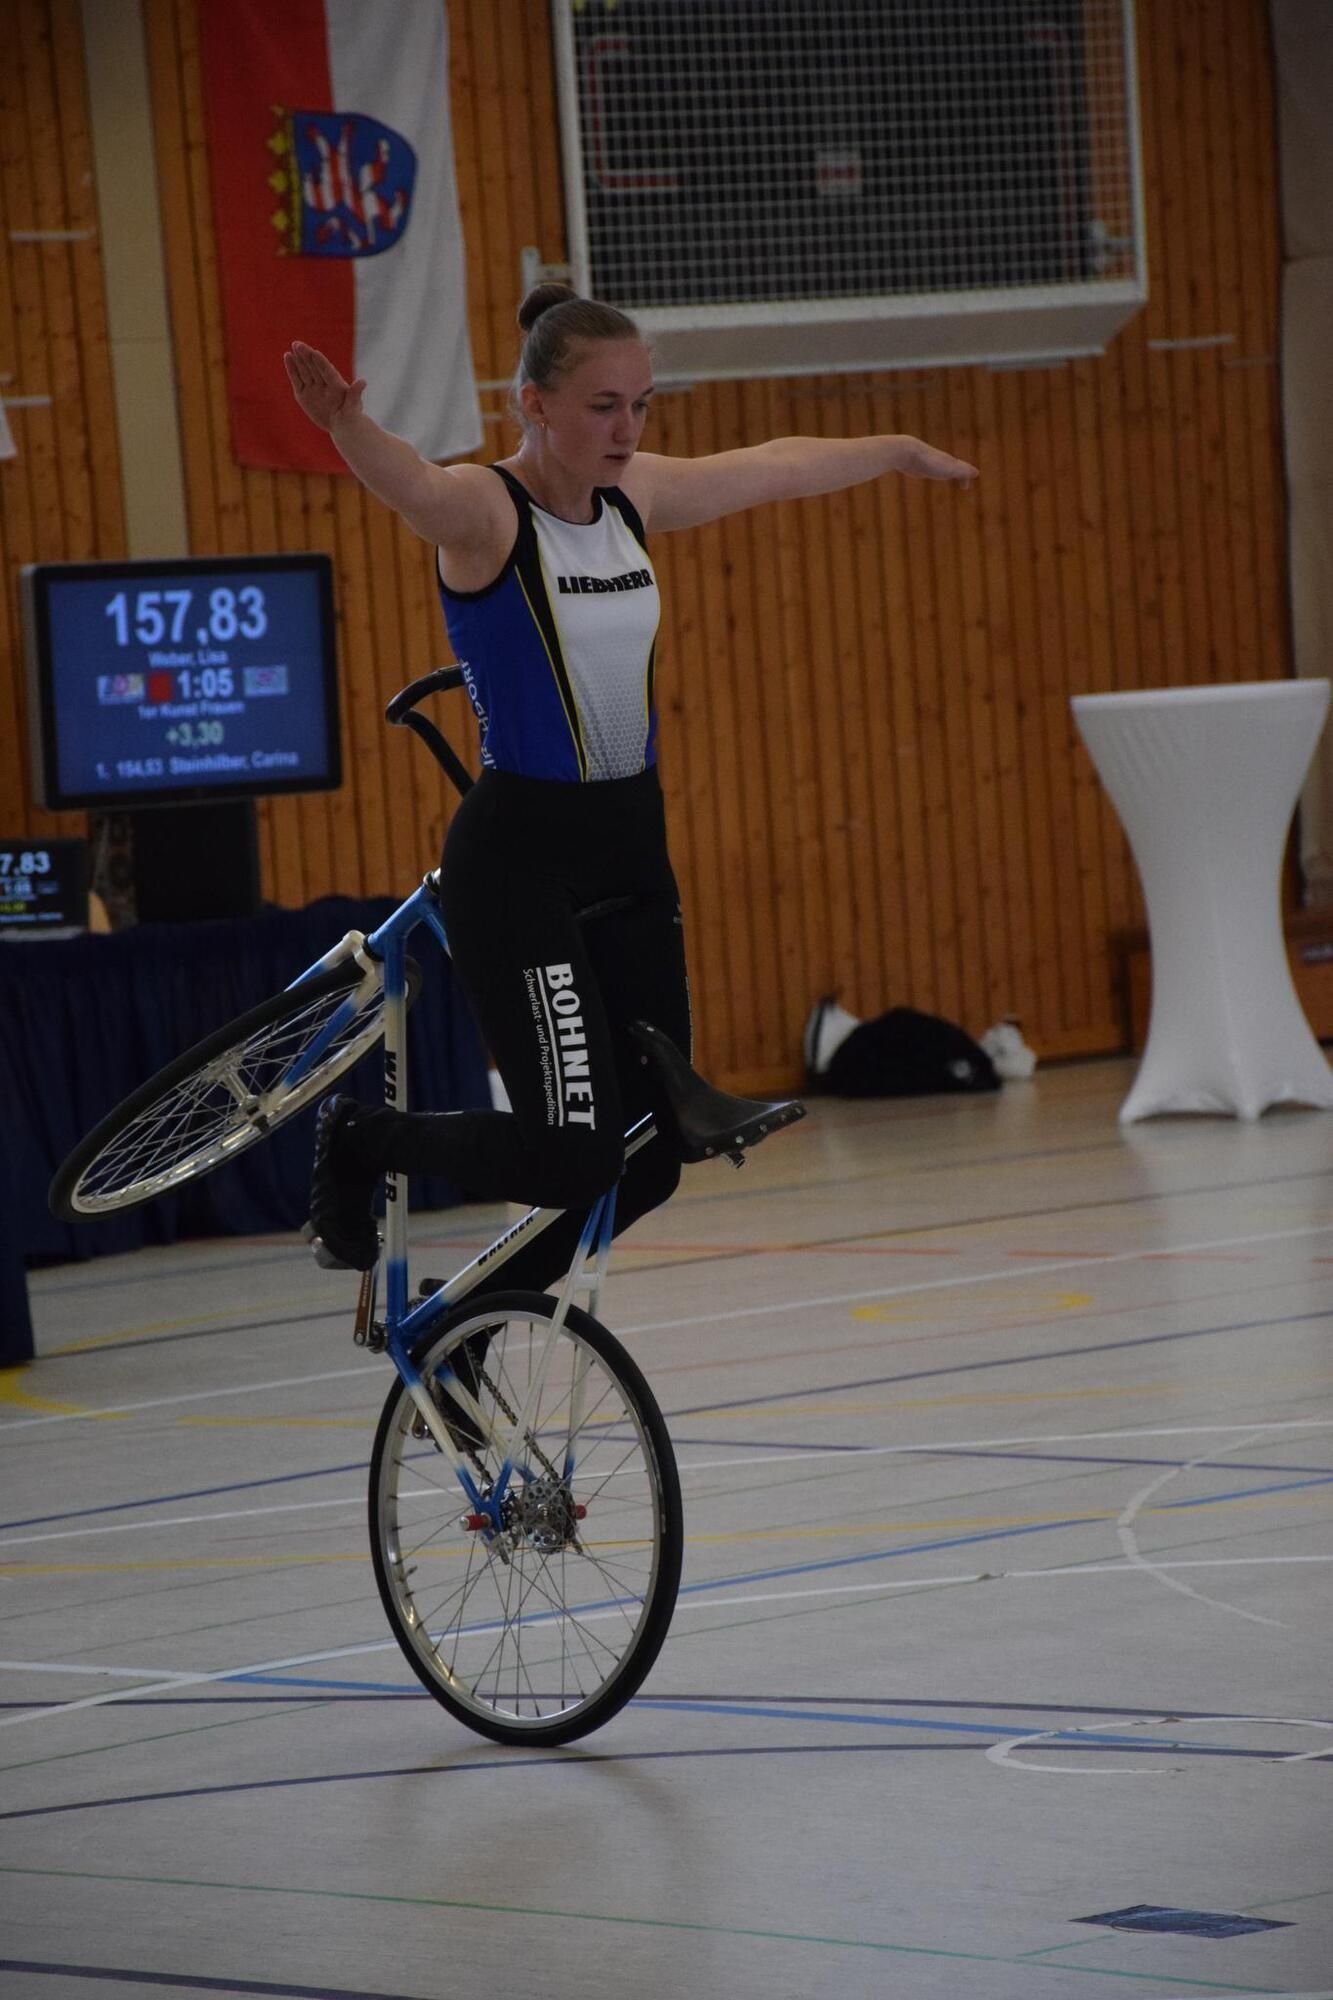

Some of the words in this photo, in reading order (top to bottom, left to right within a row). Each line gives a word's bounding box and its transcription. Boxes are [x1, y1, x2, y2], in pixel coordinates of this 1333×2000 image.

[557, 568, 654, 594] LIEBHERR
[105, 585, 268, 647] 157,83
[177, 667, 234, 699] 1:05
[523, 968, 541, 1022] Schwerlast-
[536, 1025, 549, 1044] und
[545, 963, 596, 1130] BOHNET
[540, 1045, 556, 1126] Projektspedition
